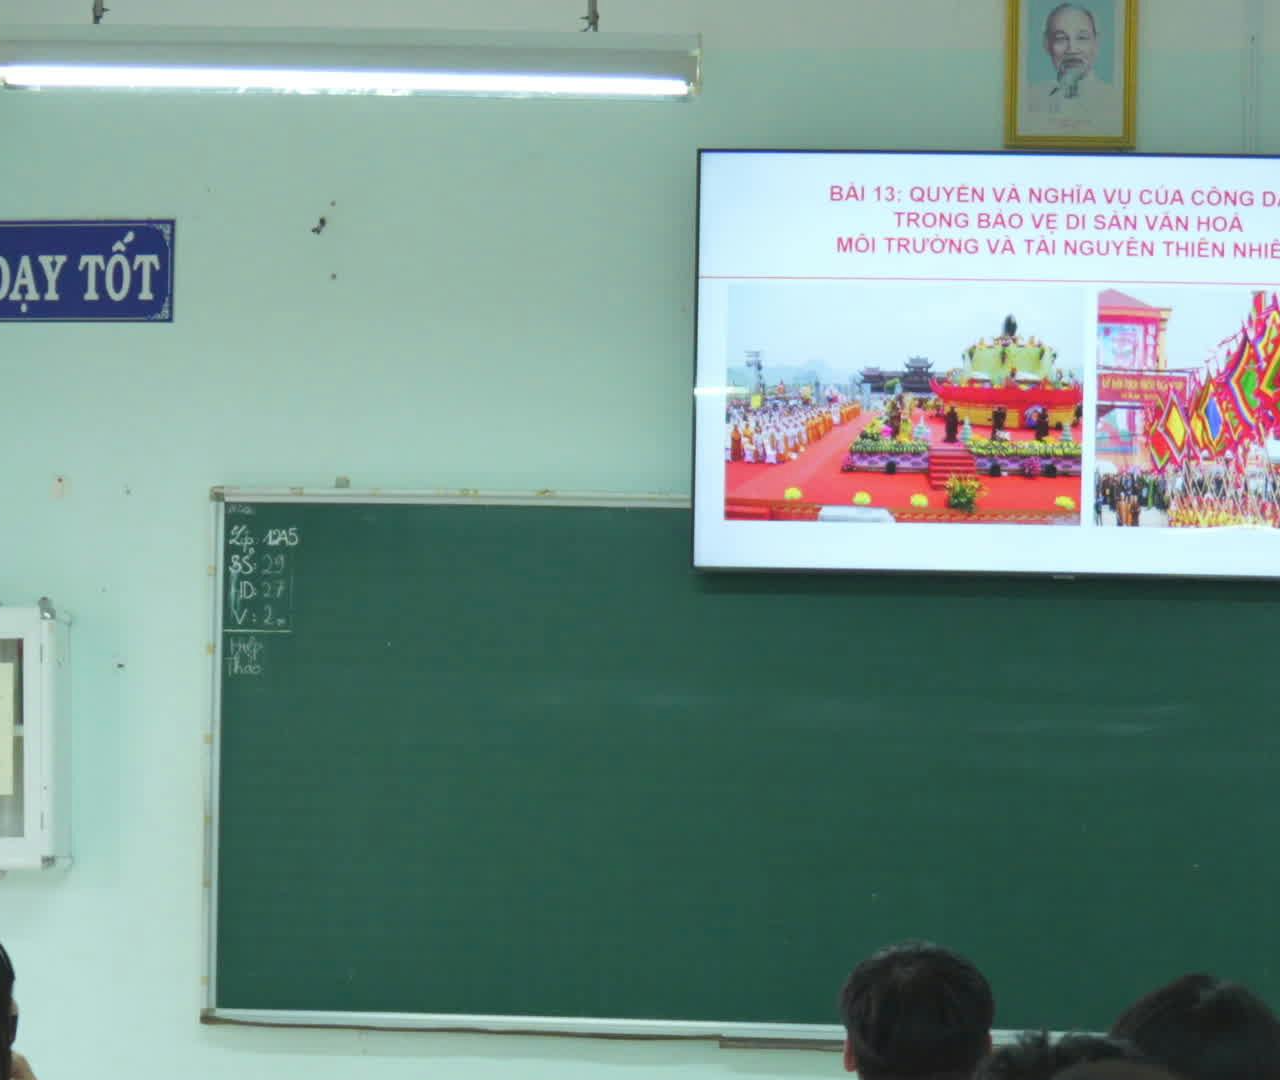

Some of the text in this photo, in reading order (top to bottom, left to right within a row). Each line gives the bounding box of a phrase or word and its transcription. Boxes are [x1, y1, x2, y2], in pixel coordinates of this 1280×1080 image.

[829, 182, 865, 202] BÀI
[873, 185, 902, 203] 13:
[991, 183, 1022, 204] VÀ
[1027, 184, 1097, 205] NGHĨA
[1103, 187, 1132, 210] VỤ
[1190, 186, 1255, 207] CÔNG
[894, 210, 970, 229] TRONG
[1030, 212, 1059, 234] VỆ
[1065, 213, 1087, 231] DI
[835, 233, 876, 254] MÔI
[884, 233, 980, 255] TRƯỜNG
[986, 235, 1017, 255] VÀ
[1023, 235, 1057, 256] TÀI
[1063, 236, 1155, 257] NGUYÊN
[1162, 237, 1226, 259] THIÊN
[77, 230, 161, 302] TỐT
